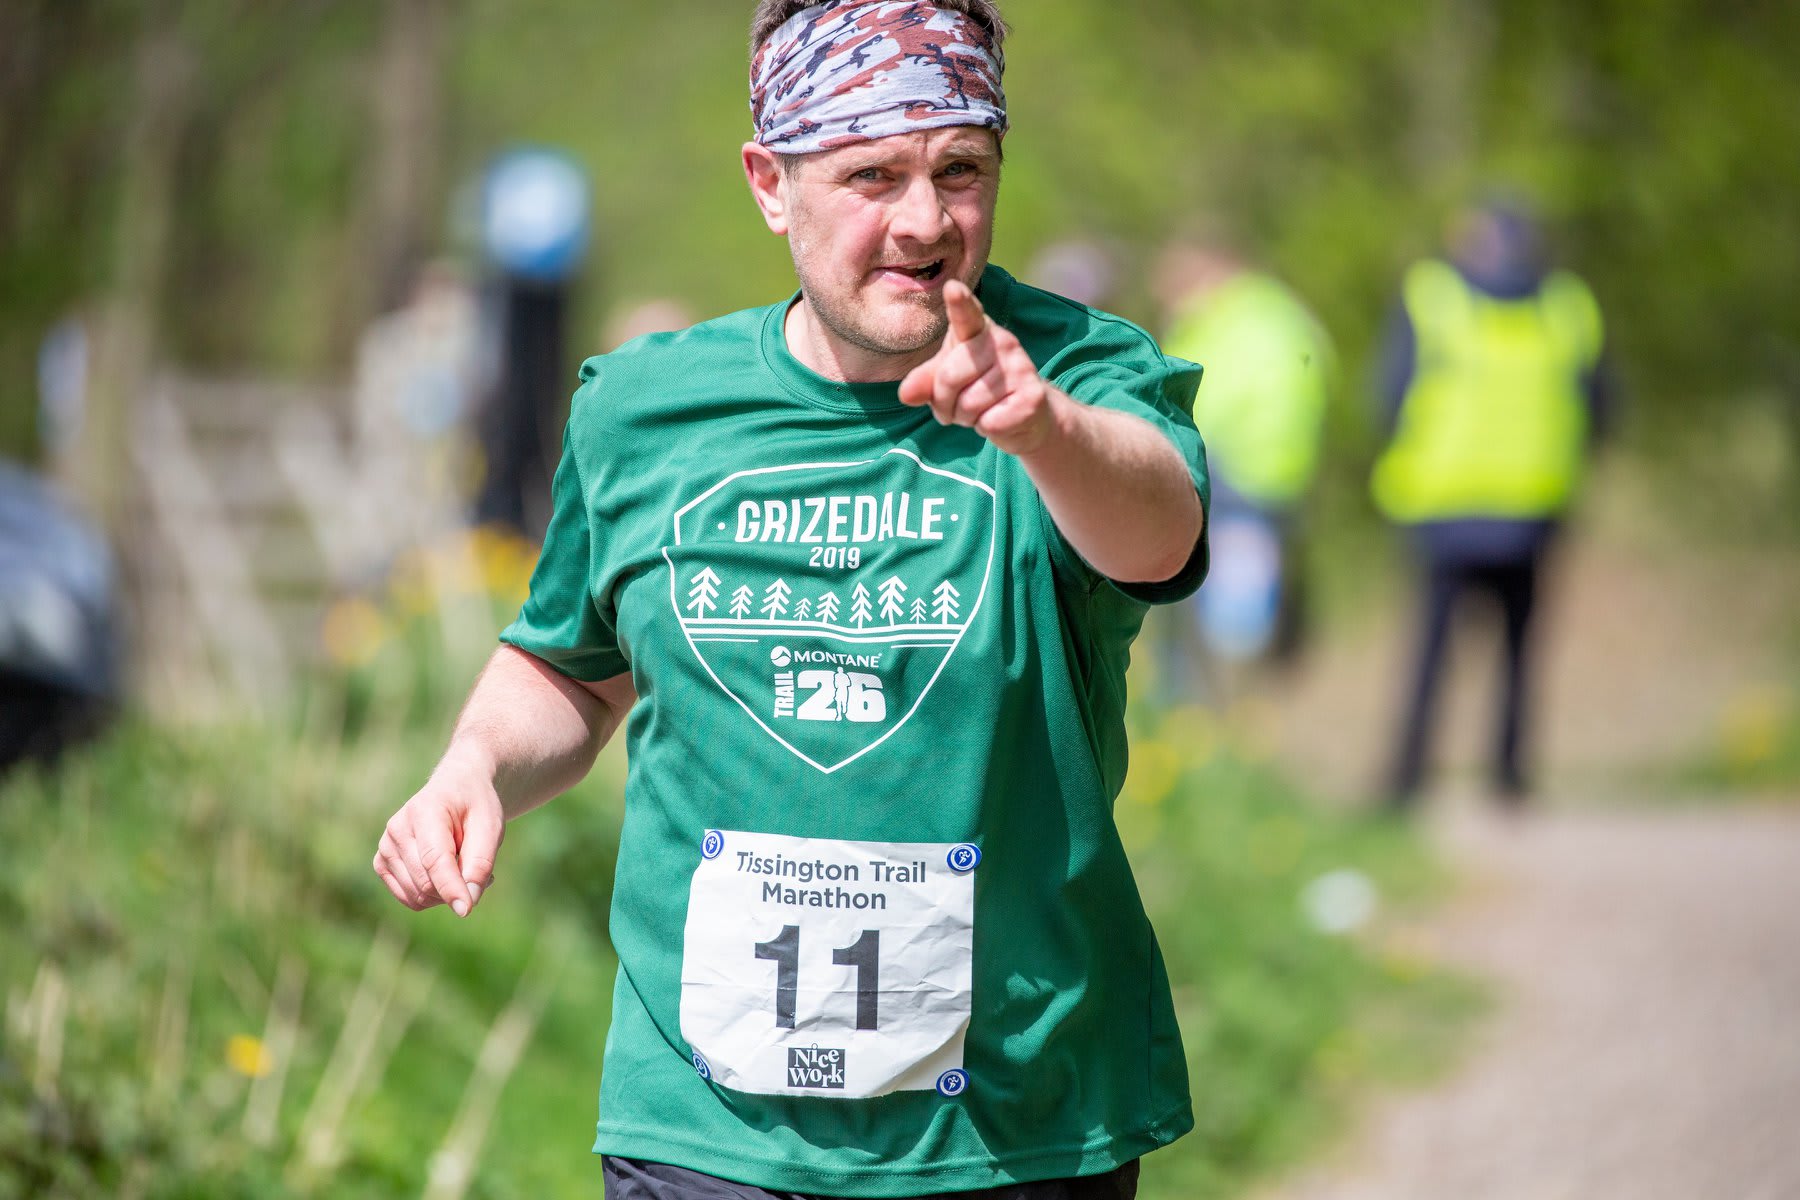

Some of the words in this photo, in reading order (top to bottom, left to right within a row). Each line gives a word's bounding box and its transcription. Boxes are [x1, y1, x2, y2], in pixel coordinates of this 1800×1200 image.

[735, 491, 945, 543] GRIZEDALE
[808, 546, 861, 569] 2019
[794, 650, 880, 668] MONTANE
[773, 671, 795, 718] TRAIL
[736, 851, 859, 883] Tissington
[869, 861, 926, 883] Trail
[762, 881, 886, 909] Marathon
[754, 924, 880, 1031] 11
[794, 1043, 840, 1069] Nice
[788, 1063, 845, 1087] Work
